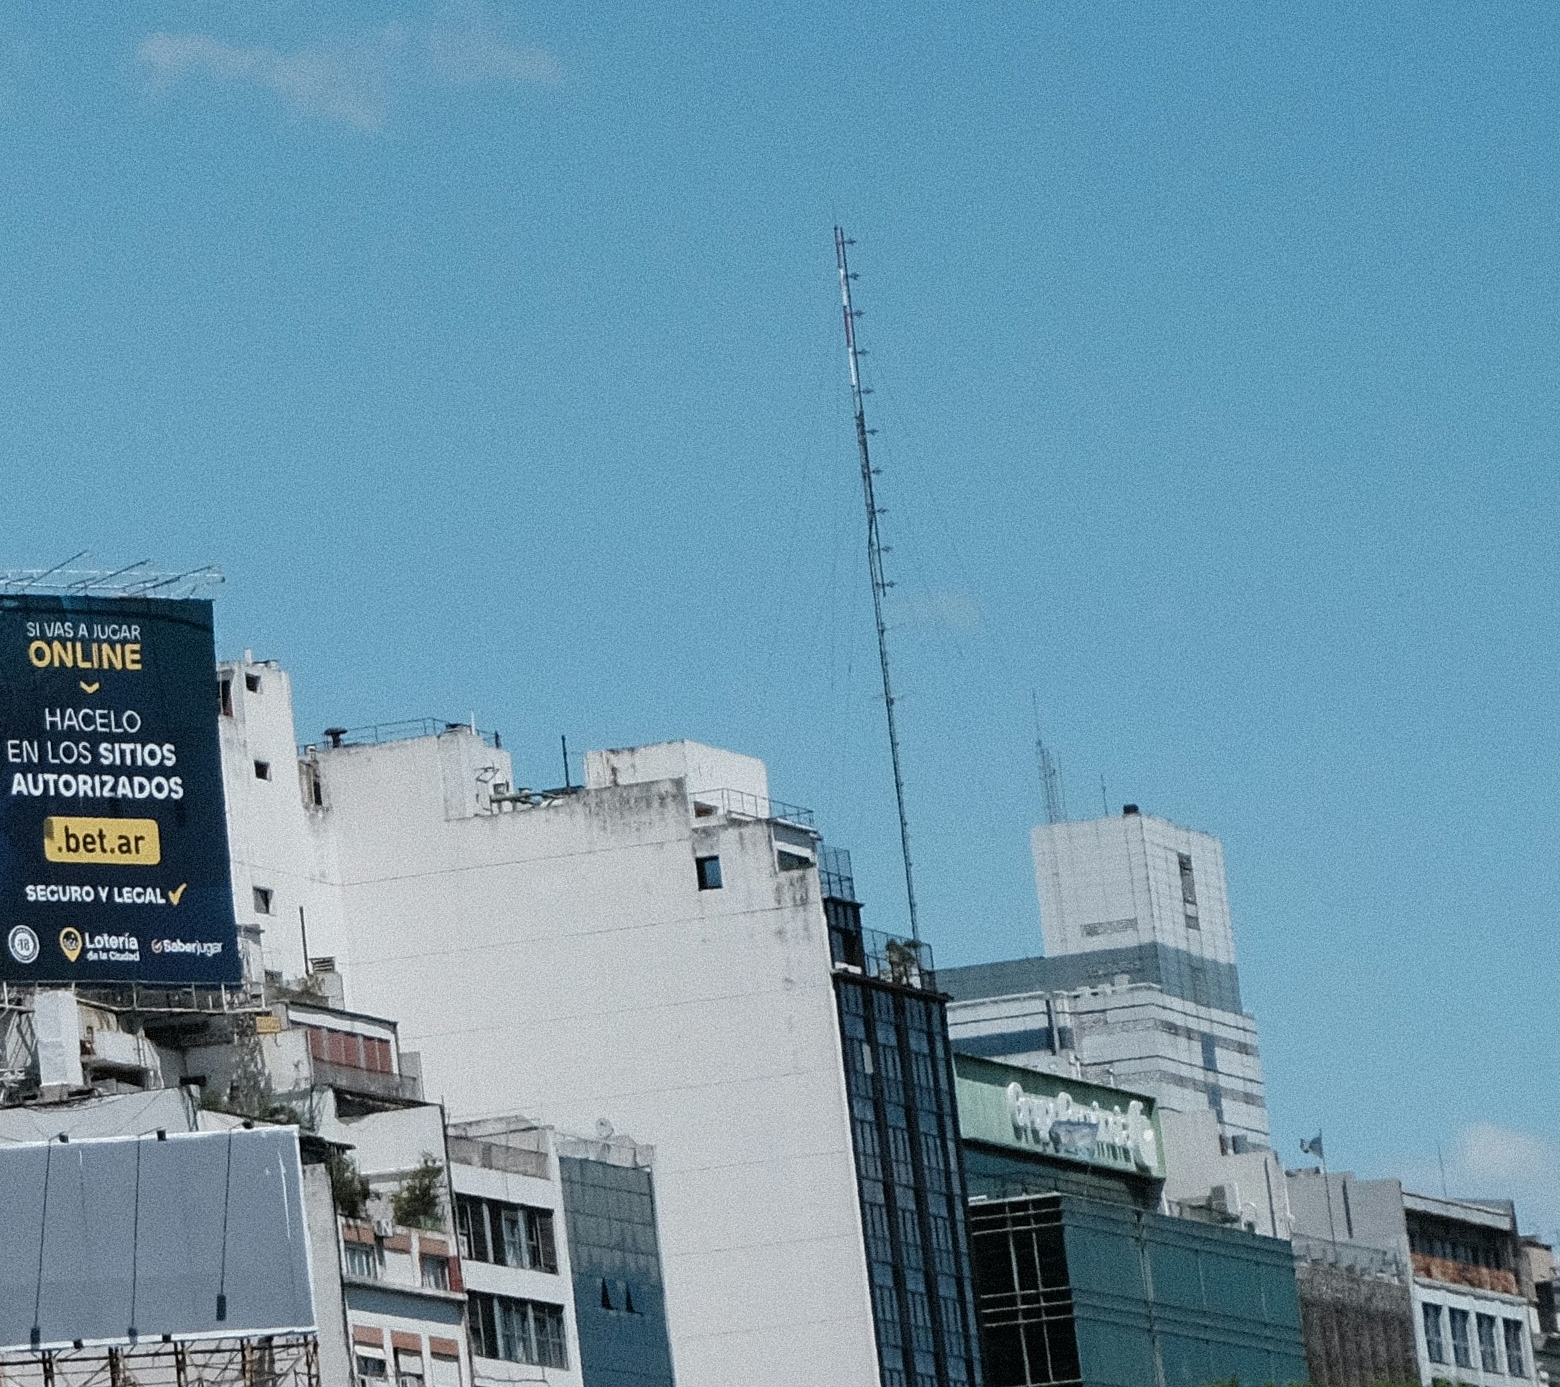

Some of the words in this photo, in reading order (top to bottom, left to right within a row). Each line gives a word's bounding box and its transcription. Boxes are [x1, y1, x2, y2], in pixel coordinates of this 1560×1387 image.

[27, 621, 39, 637] SI
[43, 622, 74, 638] VAS
[77, 623, 89, 638] A
[93, 624, 141, 640] JUGAR
[28, 640, 142, 670] ONLINE
[45, 708, 142, 733] HACELO
[7, 740, 39, 763] EN
[47, 741, 92, 764] LOS
[98, 742, 177, 767] SITIOS
[11, 773, 184, 800] AUTORIZADOS
[57, 825, 145, 855] .bet.ar
[25, 885, 95, 903] SEGURO
[98, 886, 109, 903] Y
[113, 886, 166, 904] LEGAL
[84, 932, 138, 950] Lotería
